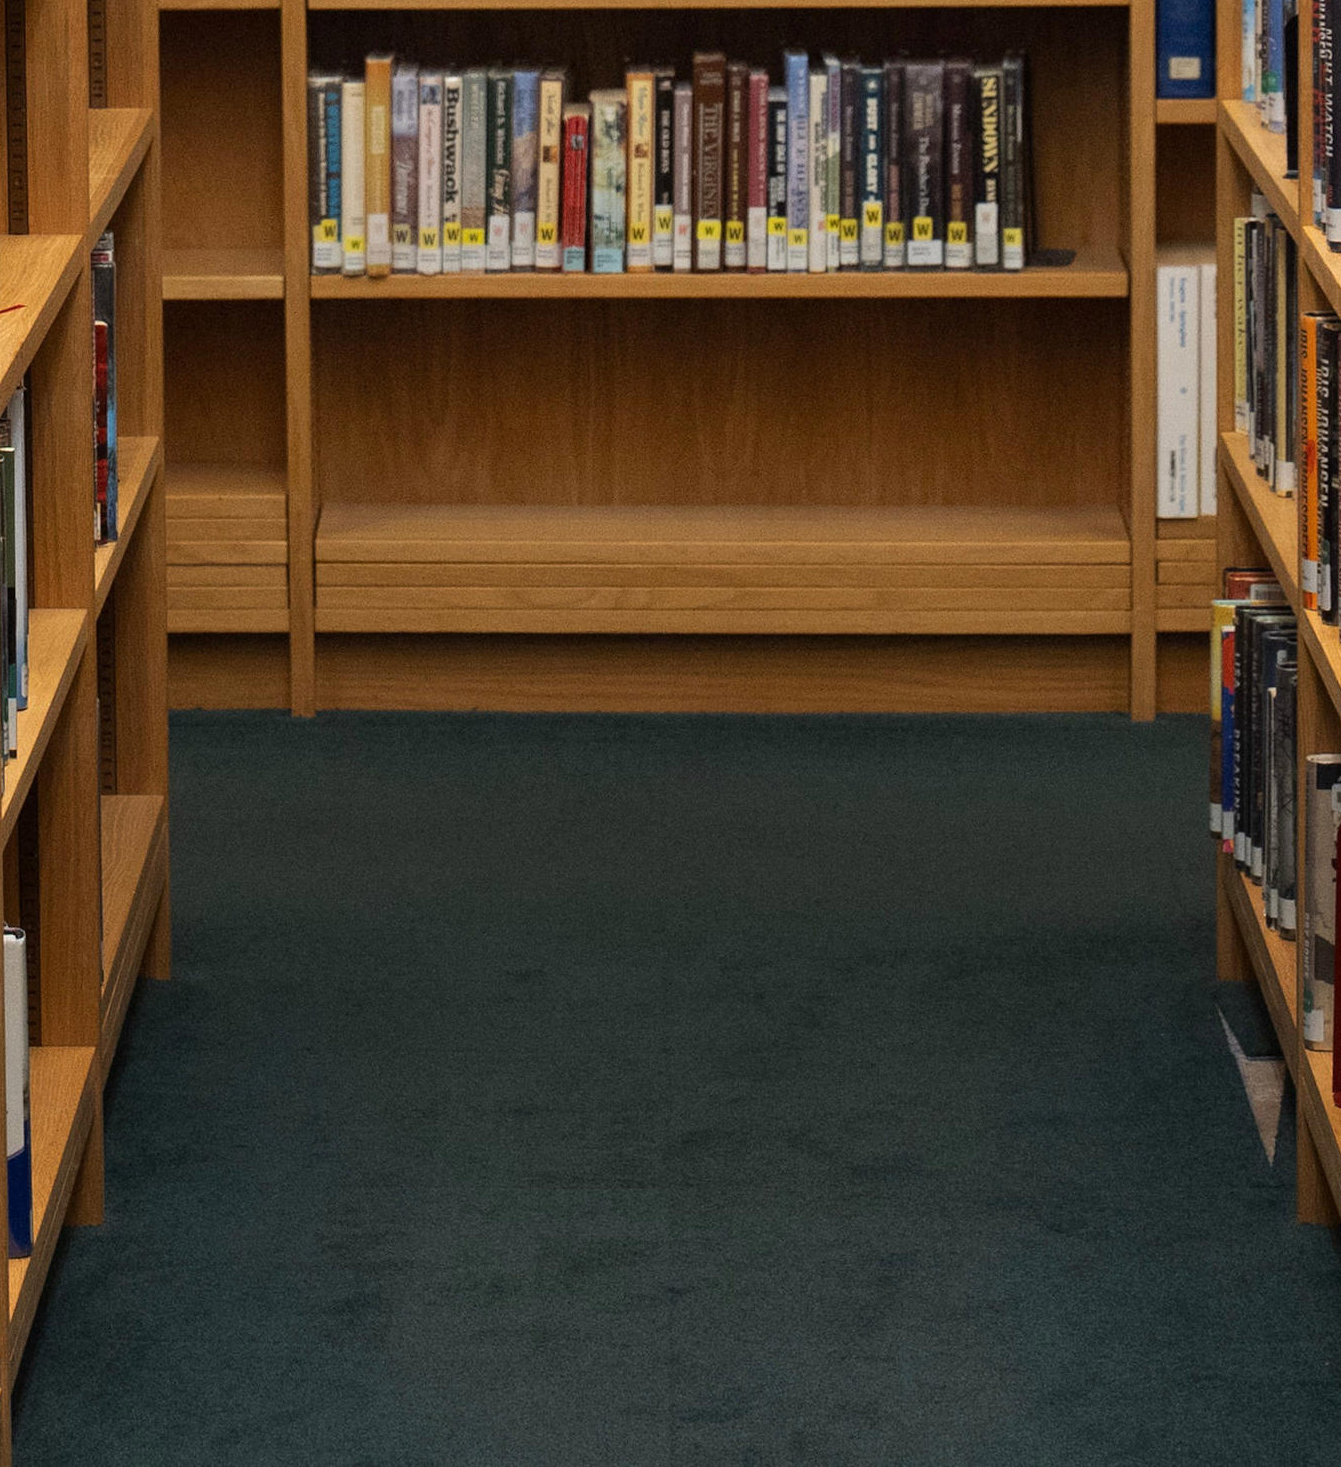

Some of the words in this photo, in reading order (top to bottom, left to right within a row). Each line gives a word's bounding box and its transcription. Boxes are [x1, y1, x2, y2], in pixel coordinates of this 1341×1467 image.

[1324, 27, 1334, 85] NIGHT
[982, 76, 999, 173] SUNDOWN
[1324, 92, 1334, 157] WATCH
[445, 87, 460, 204] Bushwack
[701, 140, 719, 219] VIRGINIA
[659, 217, 671, 229] W
[866, 210, 879, 224] W
[395, 230, 409, 242] W
[447, 229, 460, 241] W
[541, 229, 554, 242] W
[632, 229, 644, 241] W
[729, 228, 742, 240] W
[842, 224, 856, 237] W
[423, 233, 435, 245] W
[1319, 357, 1330, 398] IRIS
[1319, 407, 1330, 506] JOHANSEN
